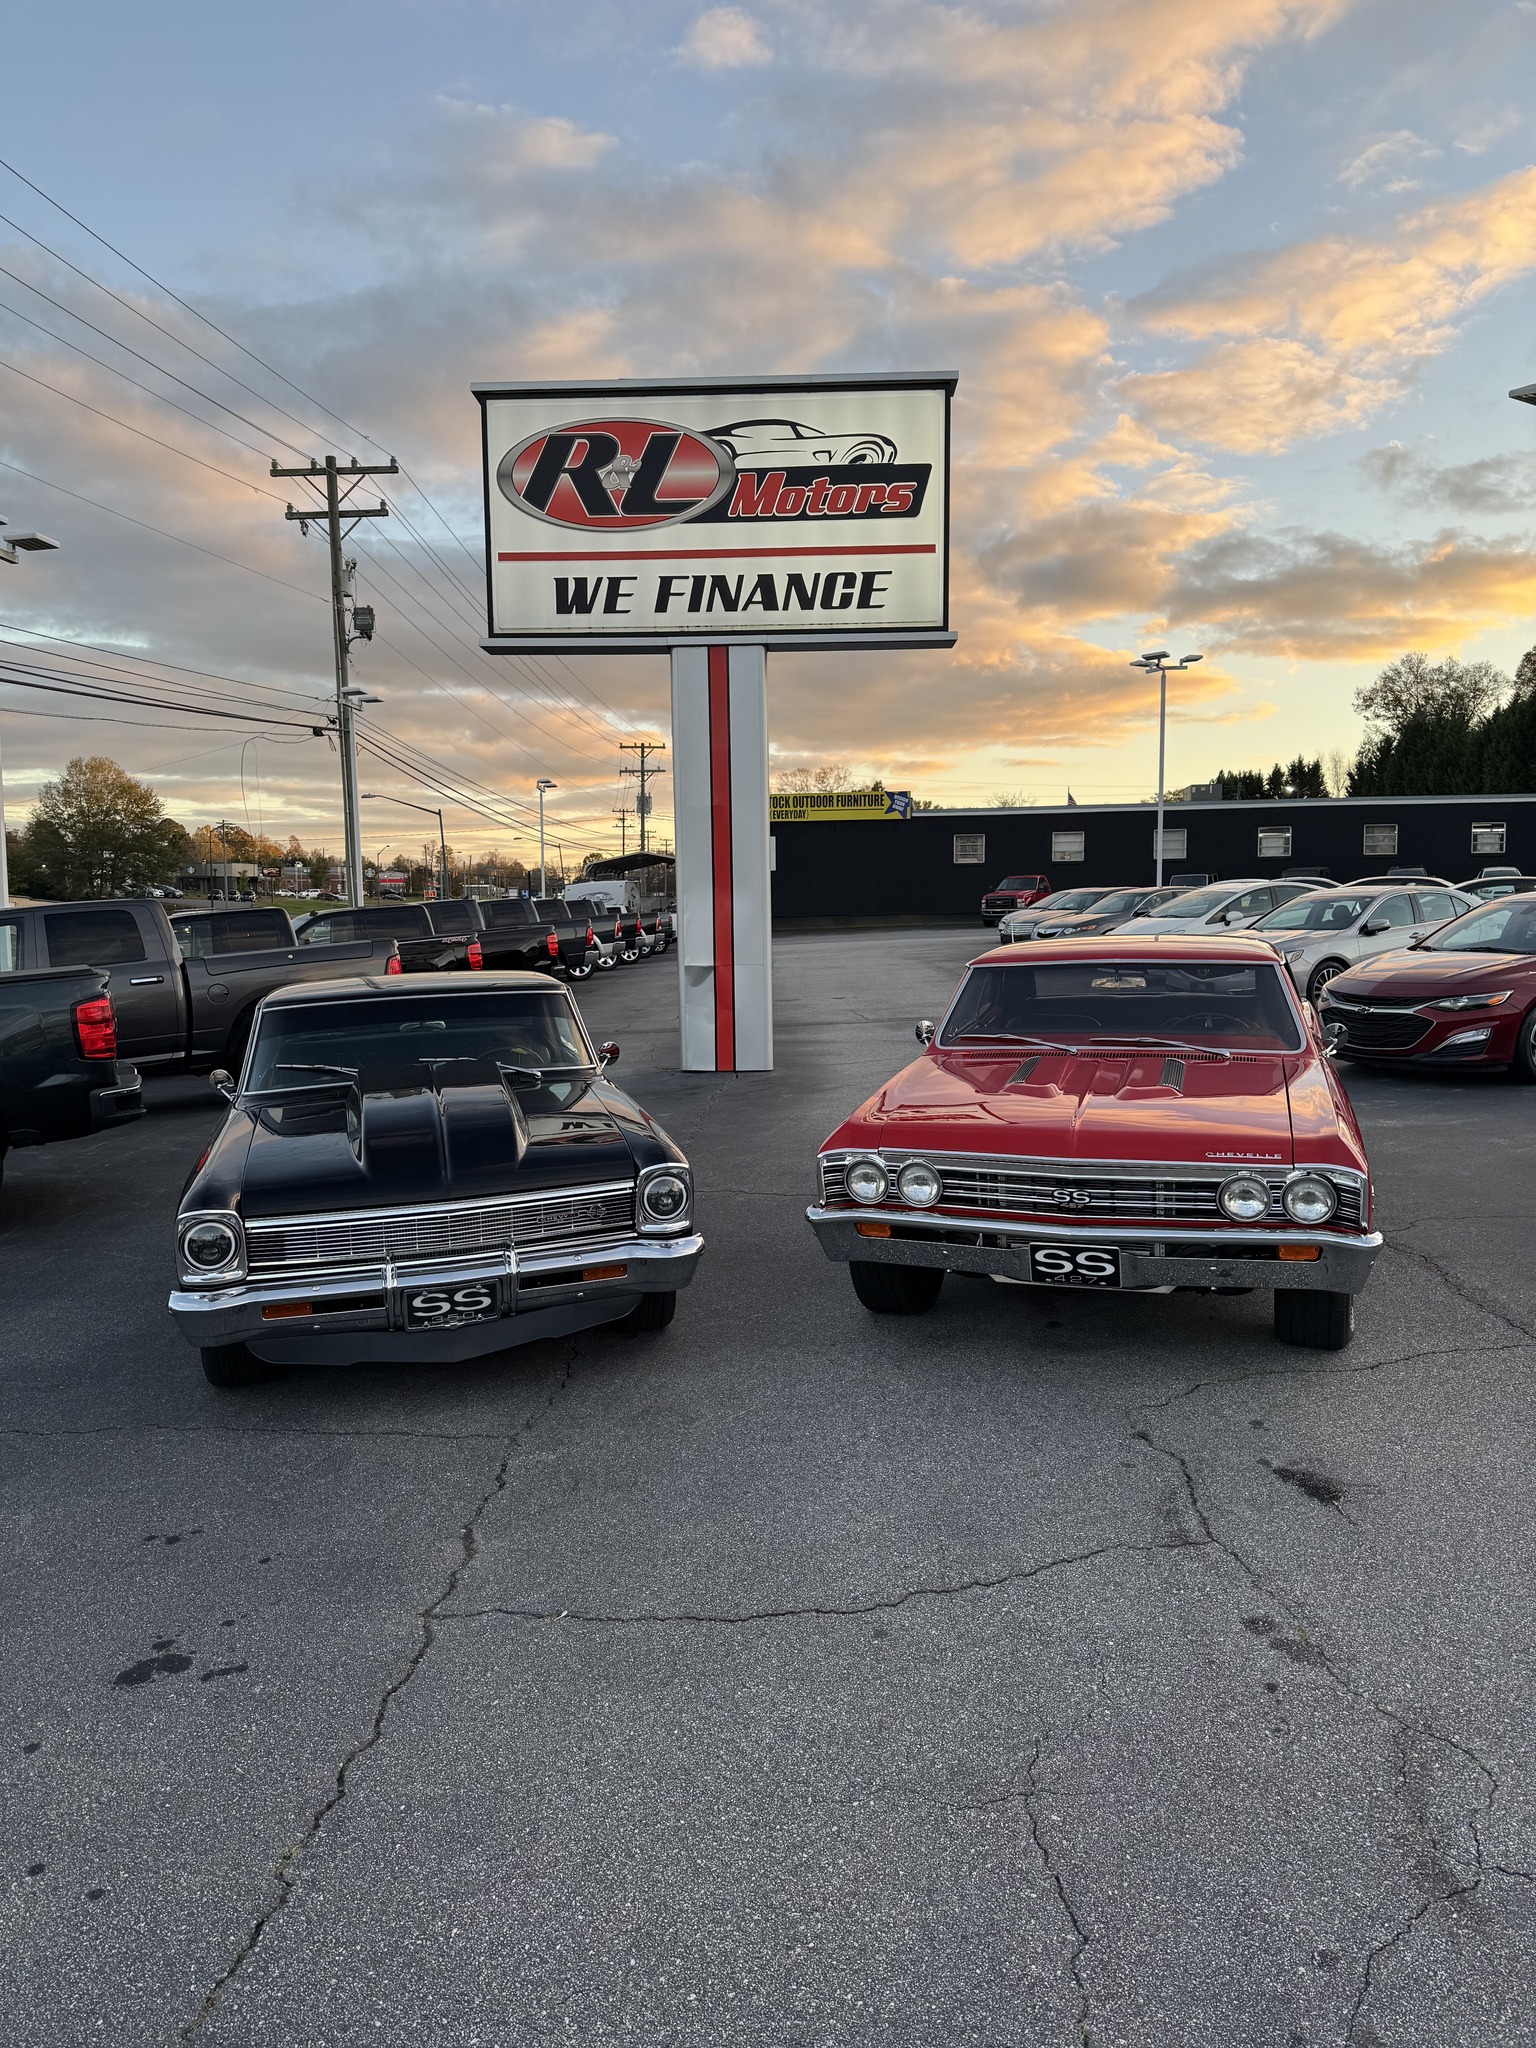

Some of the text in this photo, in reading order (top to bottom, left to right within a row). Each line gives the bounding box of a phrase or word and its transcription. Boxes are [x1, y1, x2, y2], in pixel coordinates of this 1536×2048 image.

[520, 431, 708, 517] R&L
[728, 471, 917, 518] Motors
[553, 570, 893, 614] WE FINANCE
[793, 795, 834, 809] OUTDOOR
[836, 794, 884, 808] FURNITURE
[769, 809, 809, 820] (EVERYDAY)
[1205, 1151, 1282, 1159] CHEVELLE
[1053, 1190, 1090, 1203] SS
[1034, 1249, 1116, 1276] SS
[1054, 1274, 1098, 1284] 427
[412, 1288, 492, 1316] SS
[431, 1311, 475, 1324] 350
